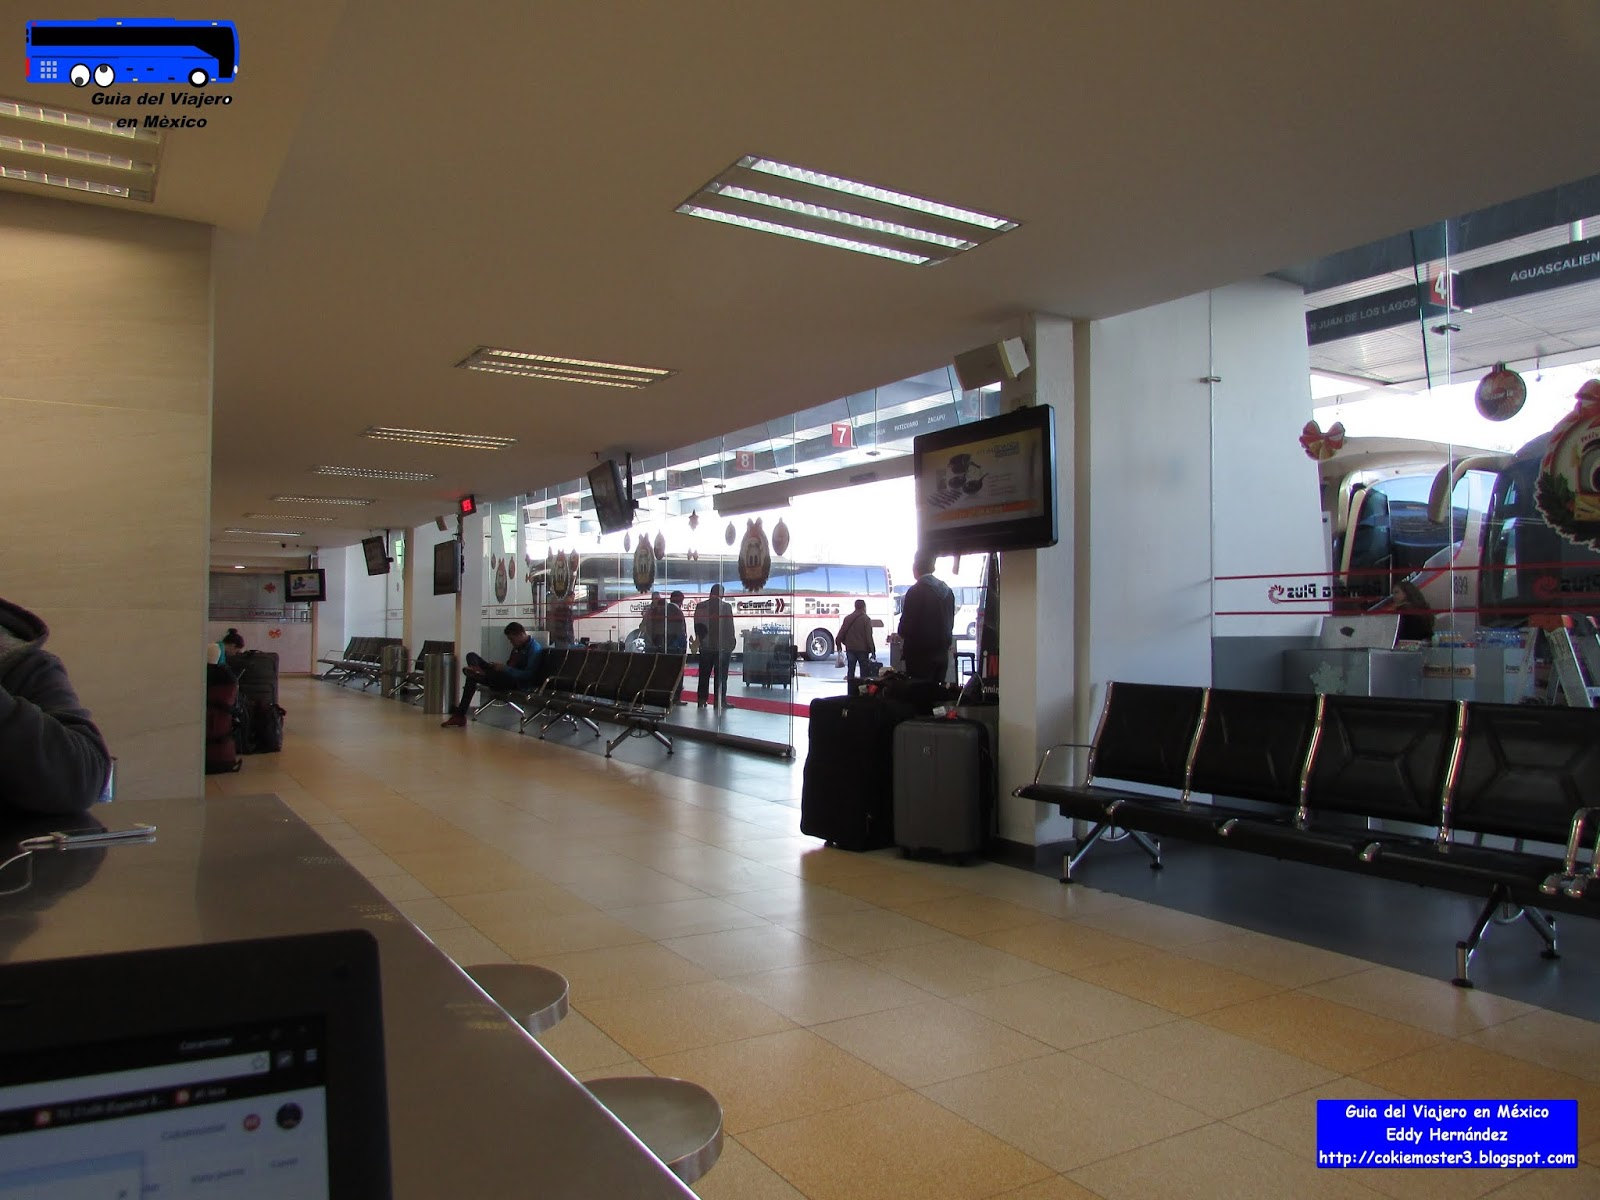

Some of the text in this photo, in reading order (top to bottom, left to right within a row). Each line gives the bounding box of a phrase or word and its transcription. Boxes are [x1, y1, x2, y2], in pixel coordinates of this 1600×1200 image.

[1510, 251, 1600, 283] AGUASCALIEN
[1433, 271, 1447, 300] 4
[1319, 315, 1344, 329] JUAN
[1344, 311, 1358, 323] DE
[1360, 306, 1380, 320] LOS
[1382, 298, 1417, 315] LAGOS
[837, 427, 847, 444] 7
[741, 453, 750, 468] 8
[804, 597, 840, 615] Plus
